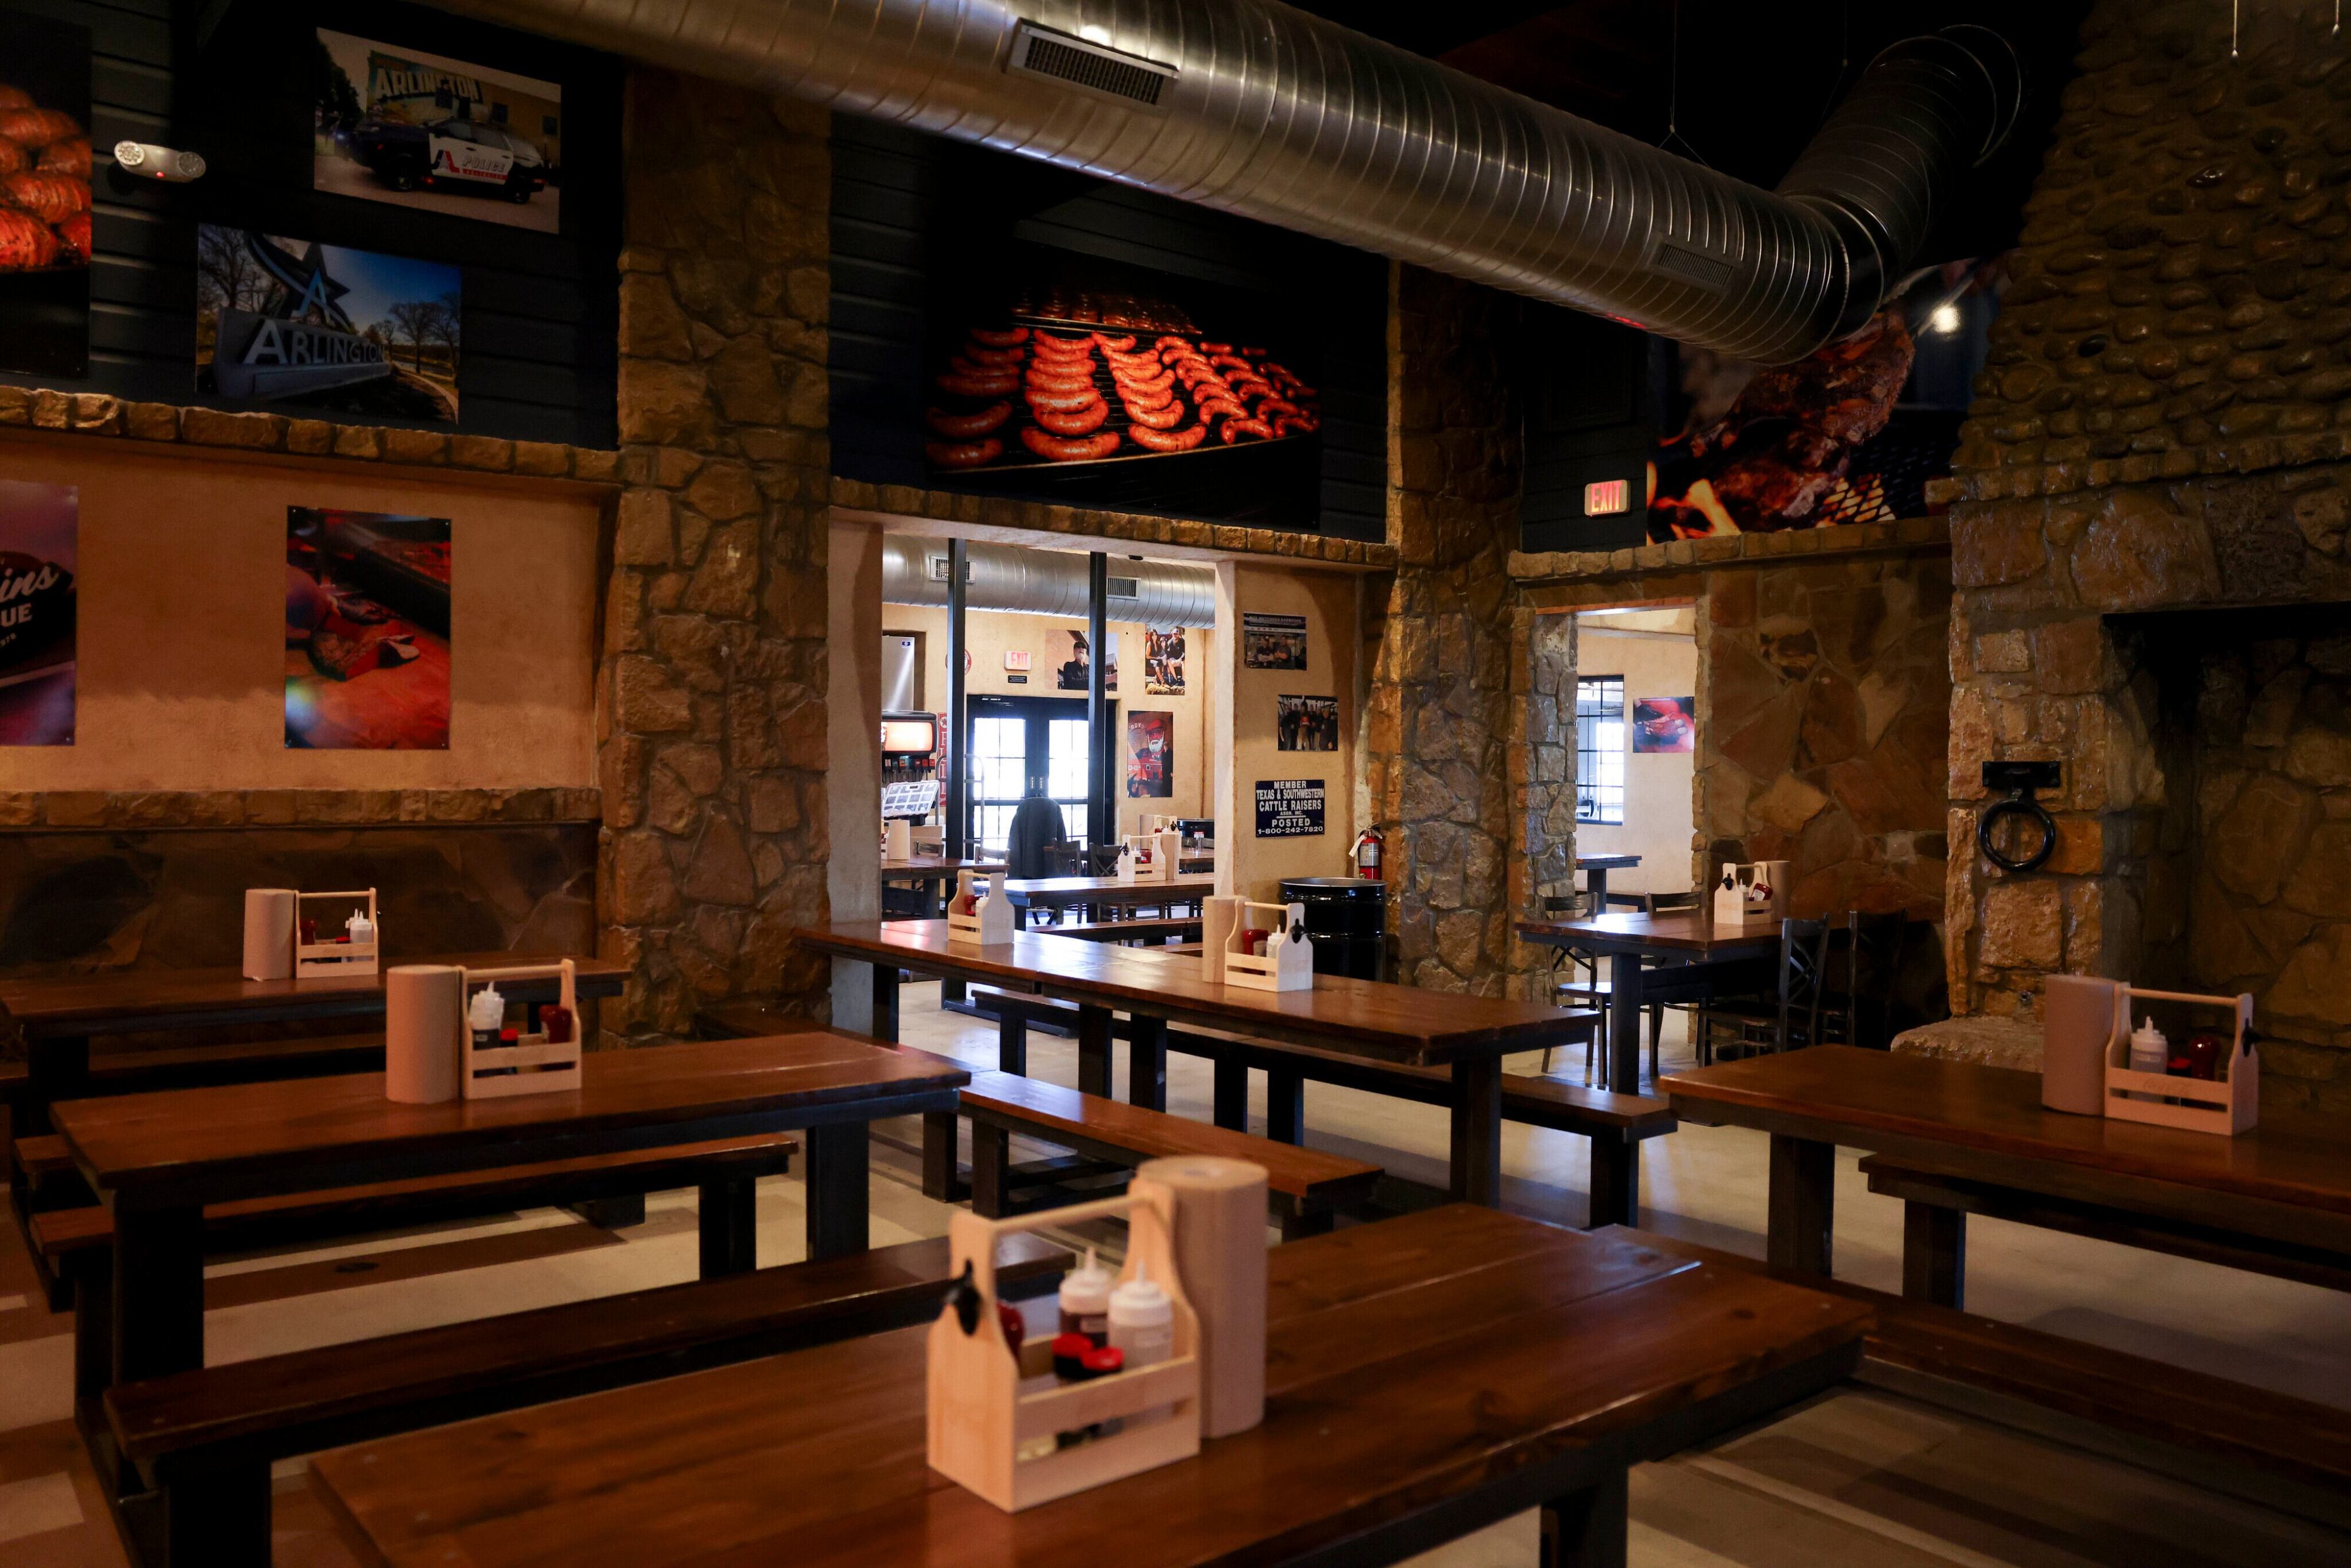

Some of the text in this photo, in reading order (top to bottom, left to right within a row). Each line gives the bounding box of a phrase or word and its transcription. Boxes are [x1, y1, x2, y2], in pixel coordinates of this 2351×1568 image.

[463, 155, 506, 172] POLICE
[243, 319, 386, 364] ARLINGTON
[1590, 481, 1622, 513] EXIT
[1011, 652, 1029, 668] EXIT
[1274, 780, 1307, 789] MEMBER
[1256, 788, 1324, 800] TEXAS & SOUTHWESTERN
[1259, 800, 1322, 812] CATTLE RAISERS
[1272, 818, 1310, 827] POSTED
[1258, 826, 1323, 835] 1-800-242-7820
